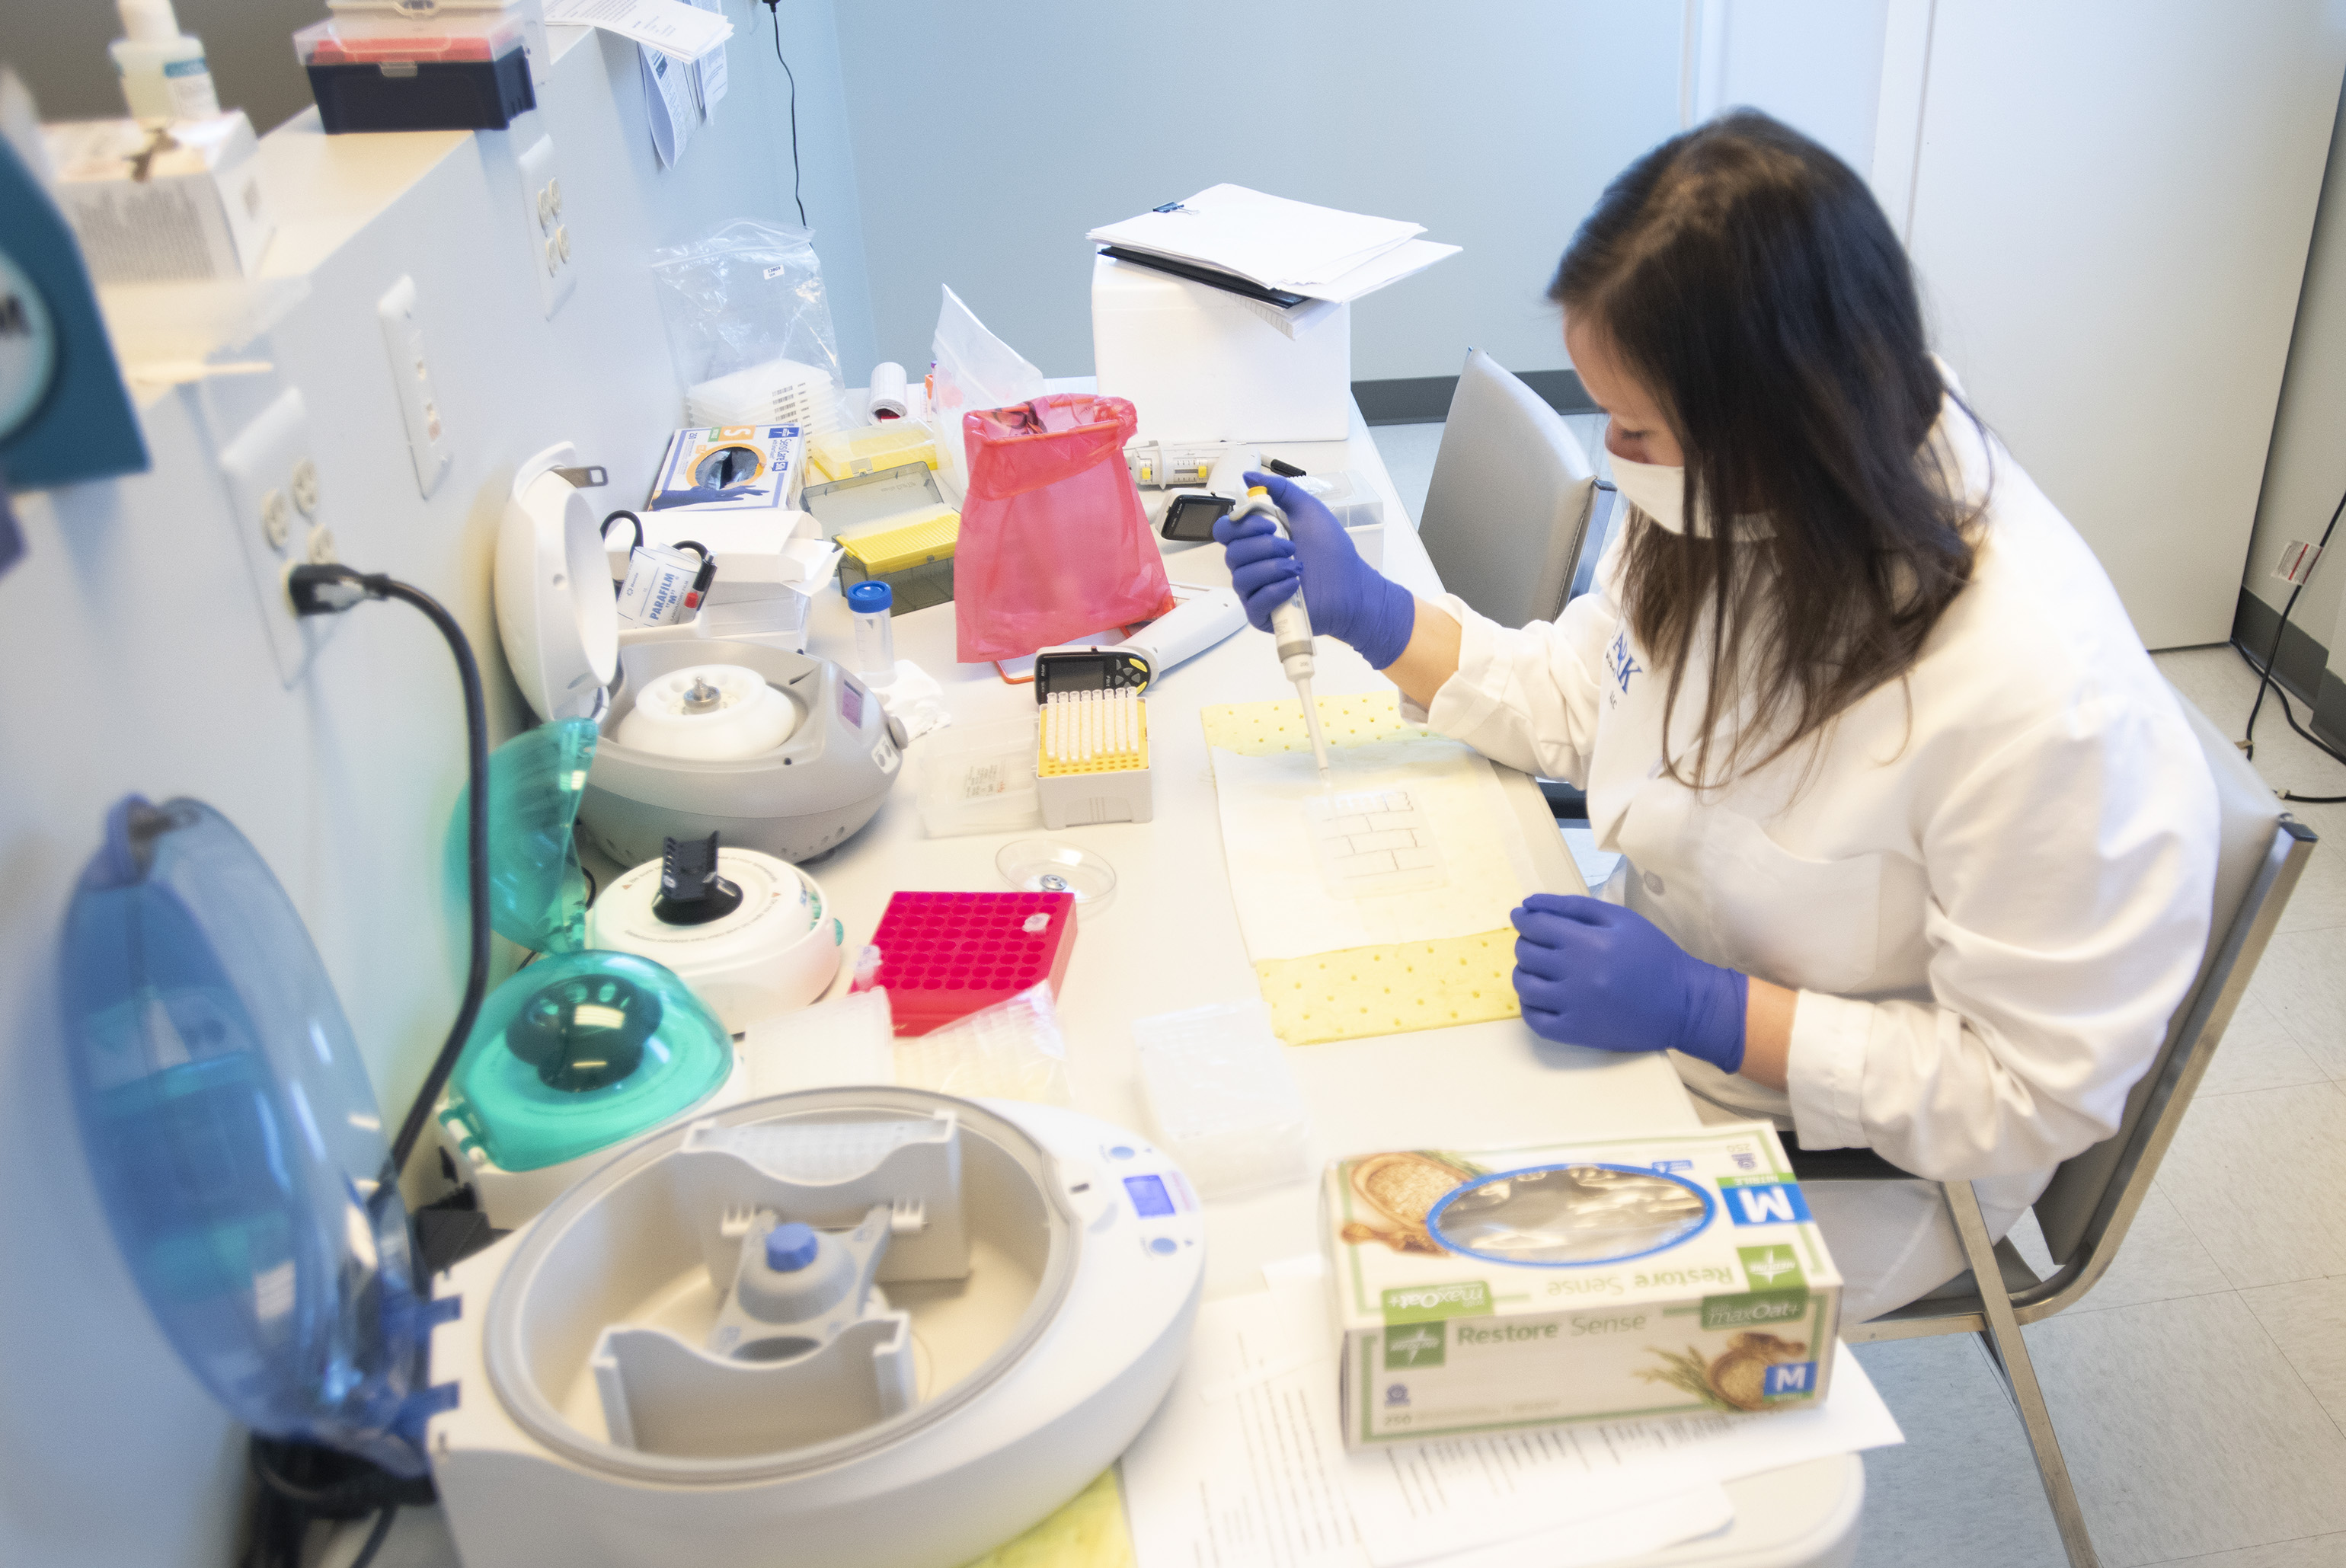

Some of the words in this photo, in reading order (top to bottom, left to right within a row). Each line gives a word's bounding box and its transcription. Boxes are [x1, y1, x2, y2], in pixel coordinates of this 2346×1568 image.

[724, 428, 752, 437] S
[649, 573, 675, 621] PARAFILM
[1739, 1186, 1795, 1222] M
[1547, 1276, 1625, 1296] Sense
[1635, 1266, 1734, 1288] Restore
[1456, 1323, 1560, 1346] Restore
[1570, 1315, 1648, 1336] Sense
[1776, 1365, 1807, 1391] M
